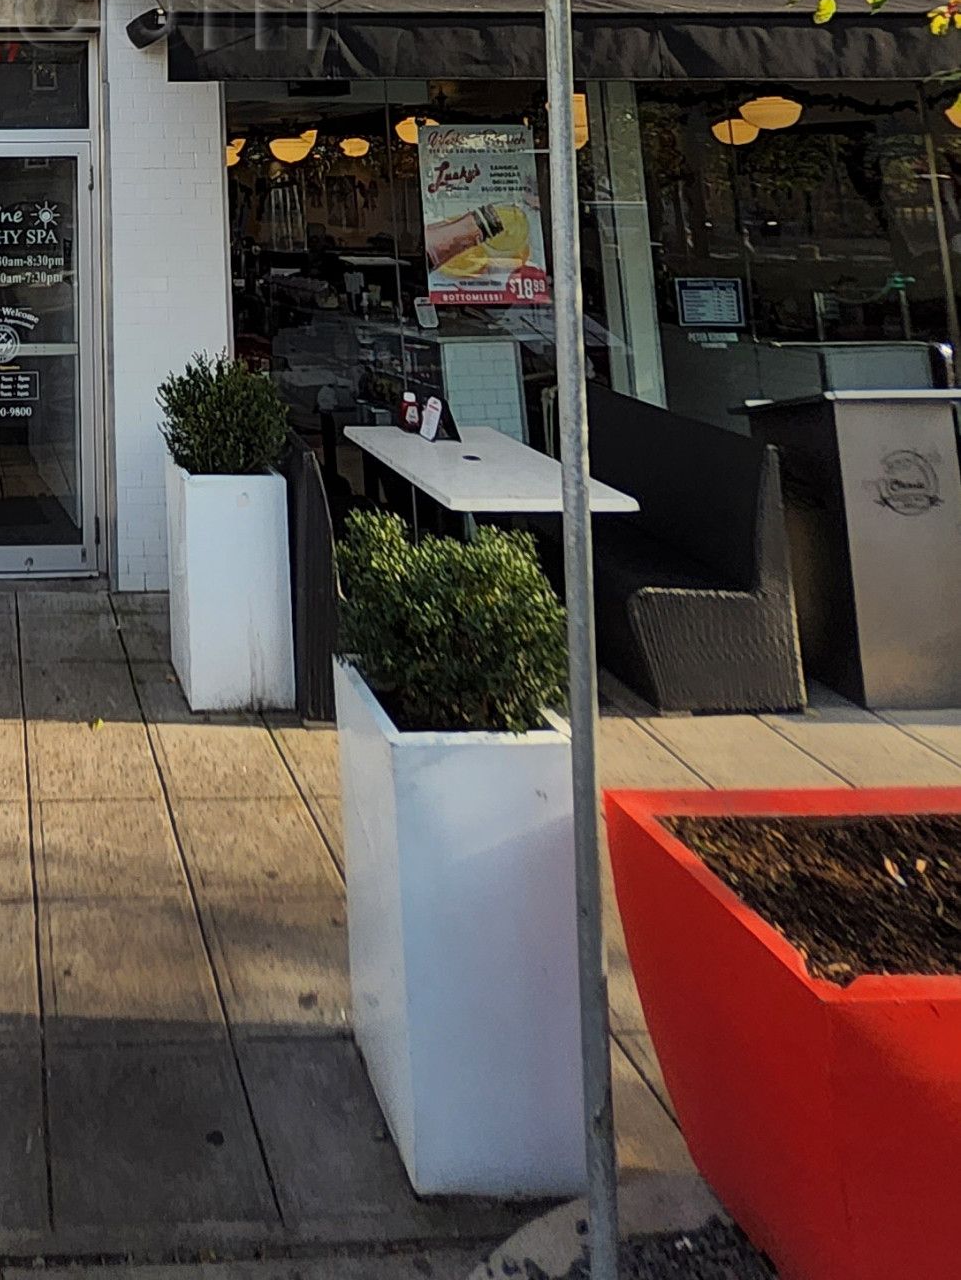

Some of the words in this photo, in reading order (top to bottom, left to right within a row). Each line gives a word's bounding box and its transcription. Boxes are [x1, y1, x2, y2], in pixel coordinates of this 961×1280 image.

[26, 229, 58, 245] SPA
[442, 293, 504, 302] BOTTOMLESS!
[1, 307, 40, 324] Welcome
